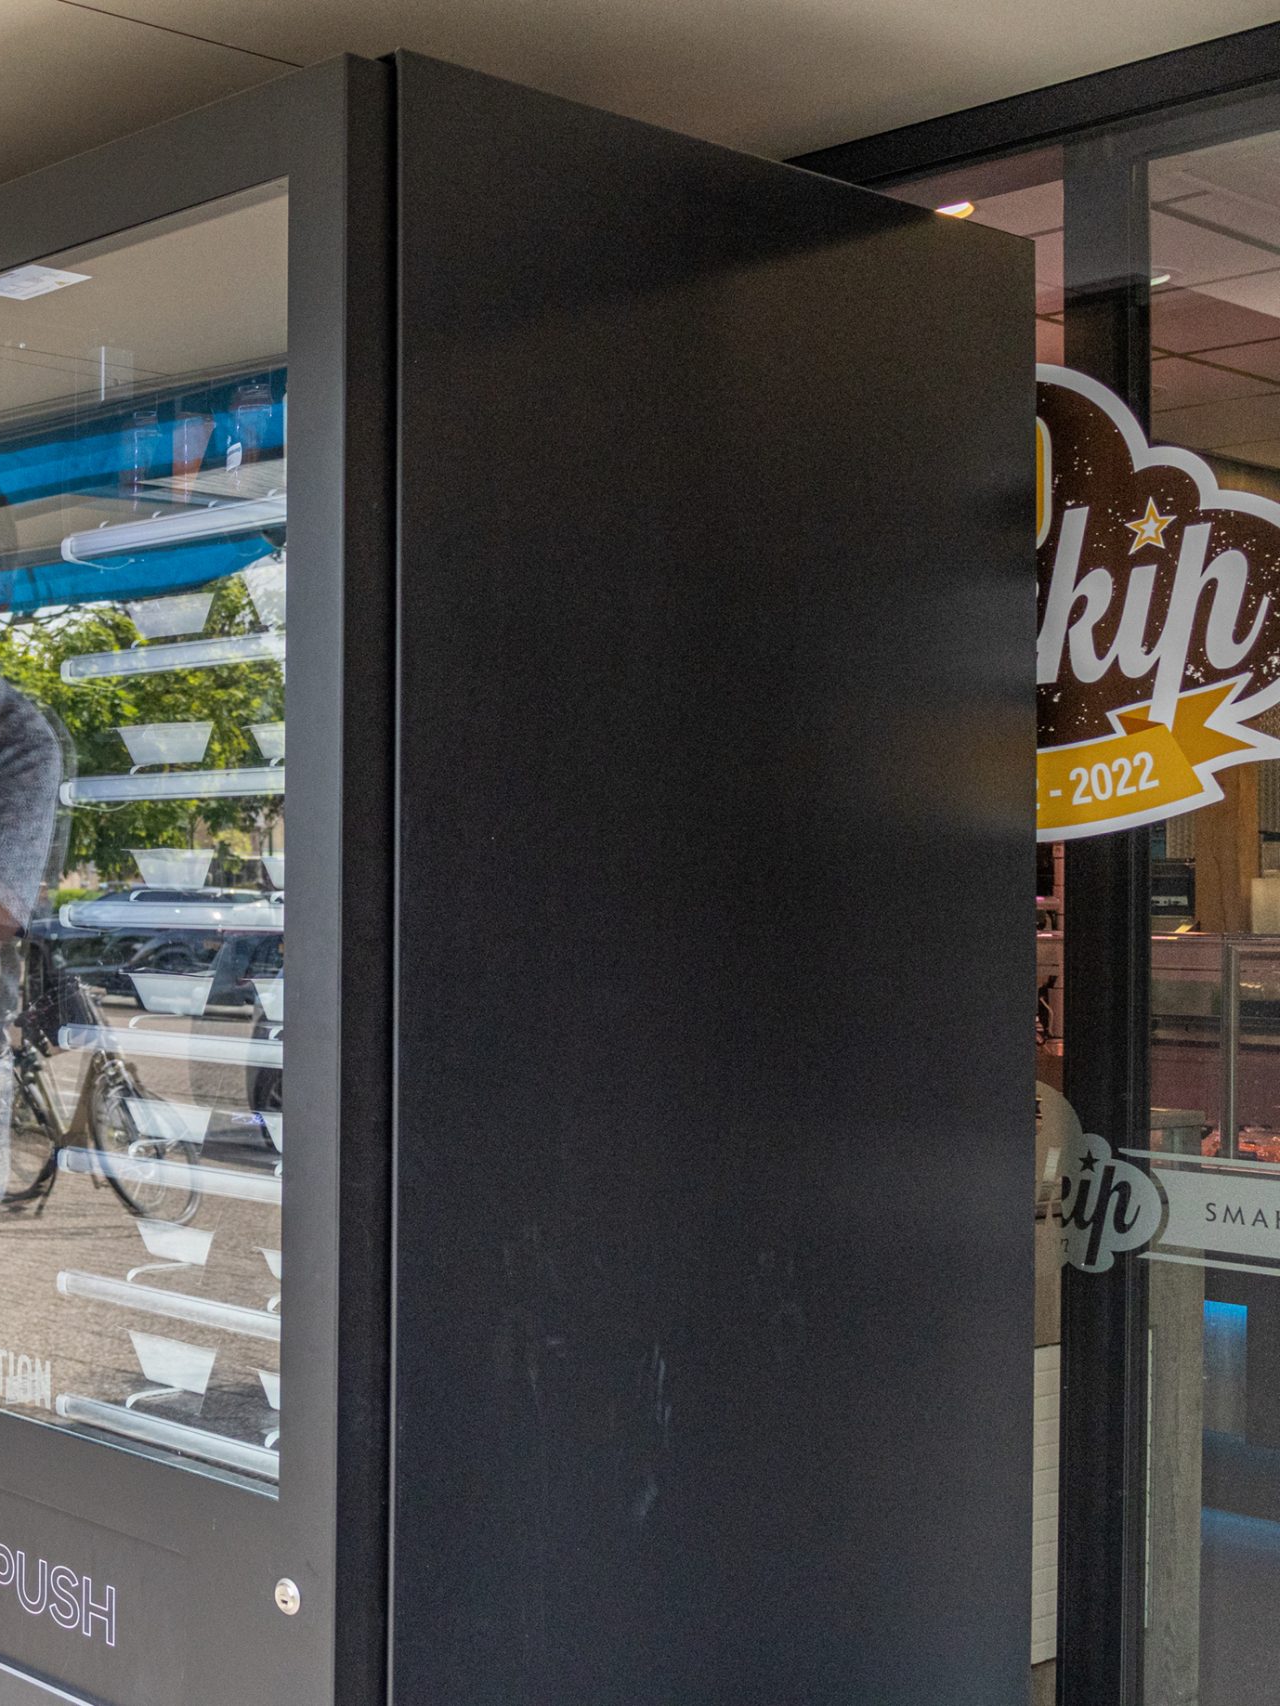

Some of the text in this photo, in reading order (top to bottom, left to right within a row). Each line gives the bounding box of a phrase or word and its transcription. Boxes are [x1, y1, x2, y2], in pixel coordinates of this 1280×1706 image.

[1036, 503, 1269, 728] kip
[1069, 751, 1160, 806] 2022
[1205, 1202, 1280, 1230] SMA
